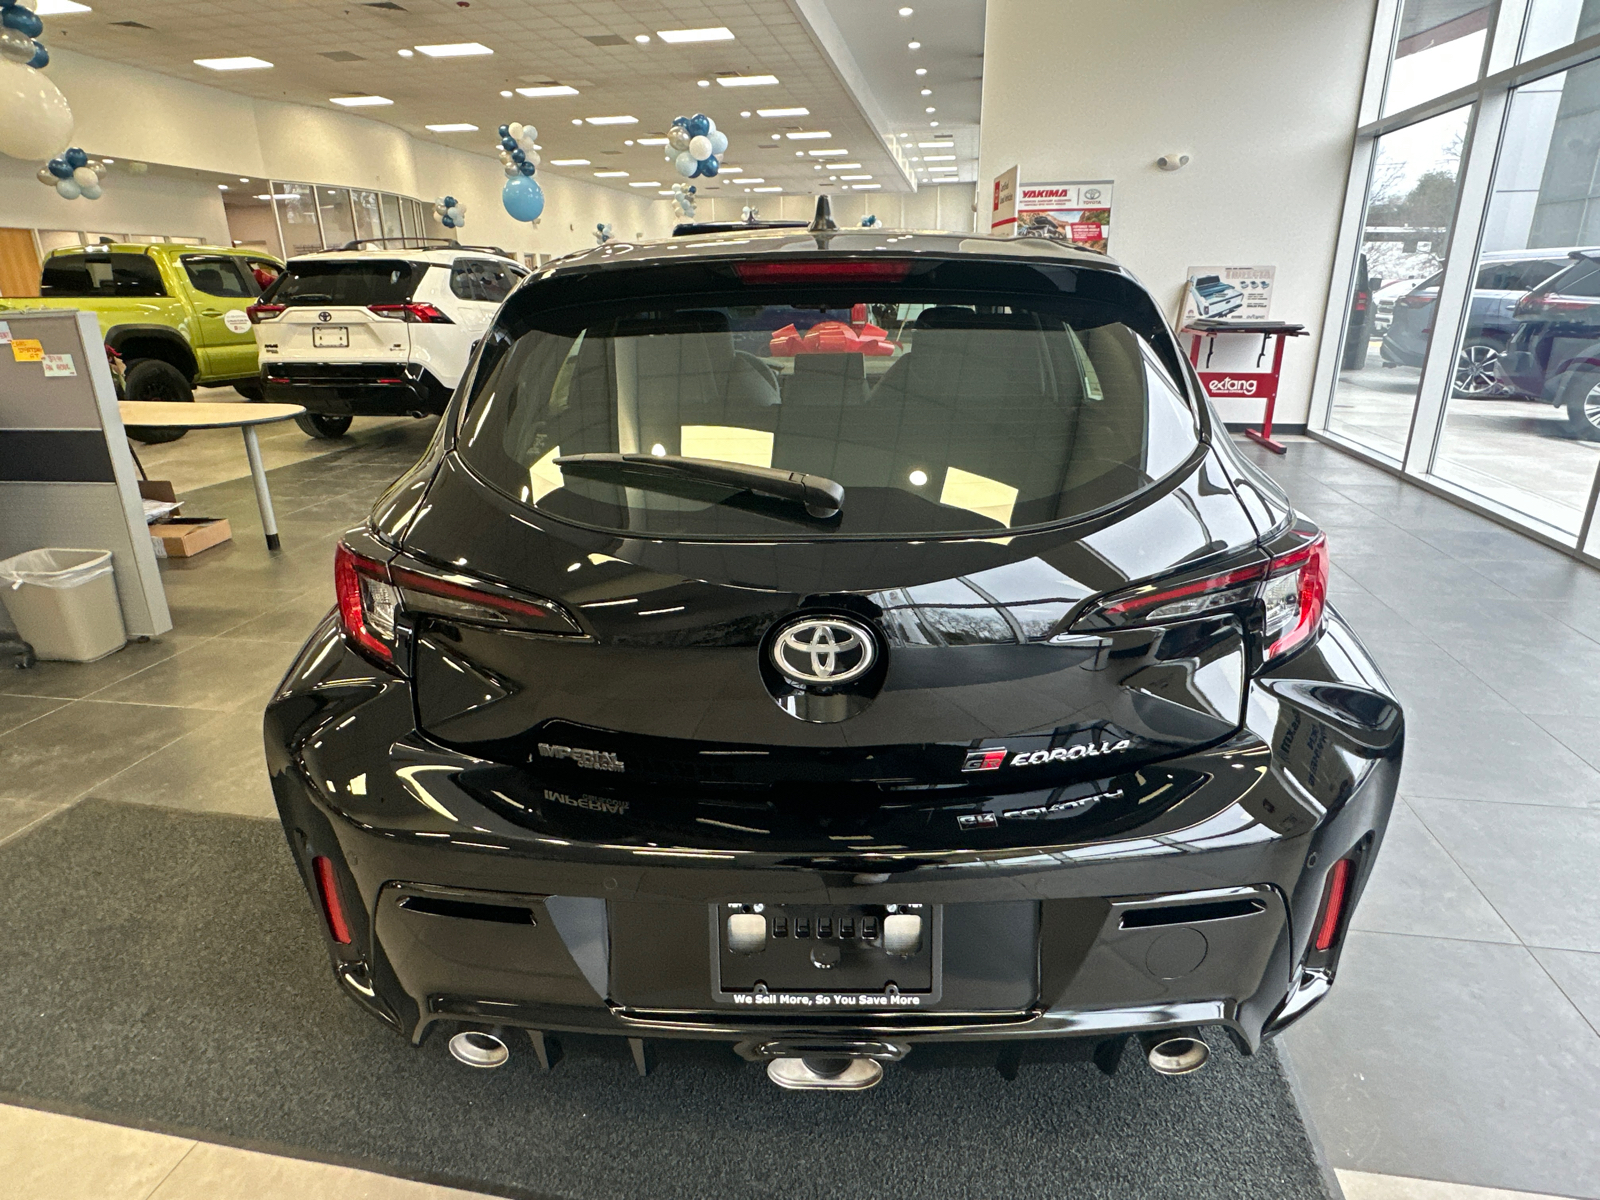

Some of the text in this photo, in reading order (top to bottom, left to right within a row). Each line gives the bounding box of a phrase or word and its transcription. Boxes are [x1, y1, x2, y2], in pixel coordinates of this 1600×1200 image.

[1022, 189, 1068, 198] YAKIMA
[1209, 376, 1257, 395] extang
[538, 743, 624, 765] IMPERIAL
[1010, 739, 1130, 766] COROLLA
[734, 994, 920, 1006] We Sell More, So You Save More
